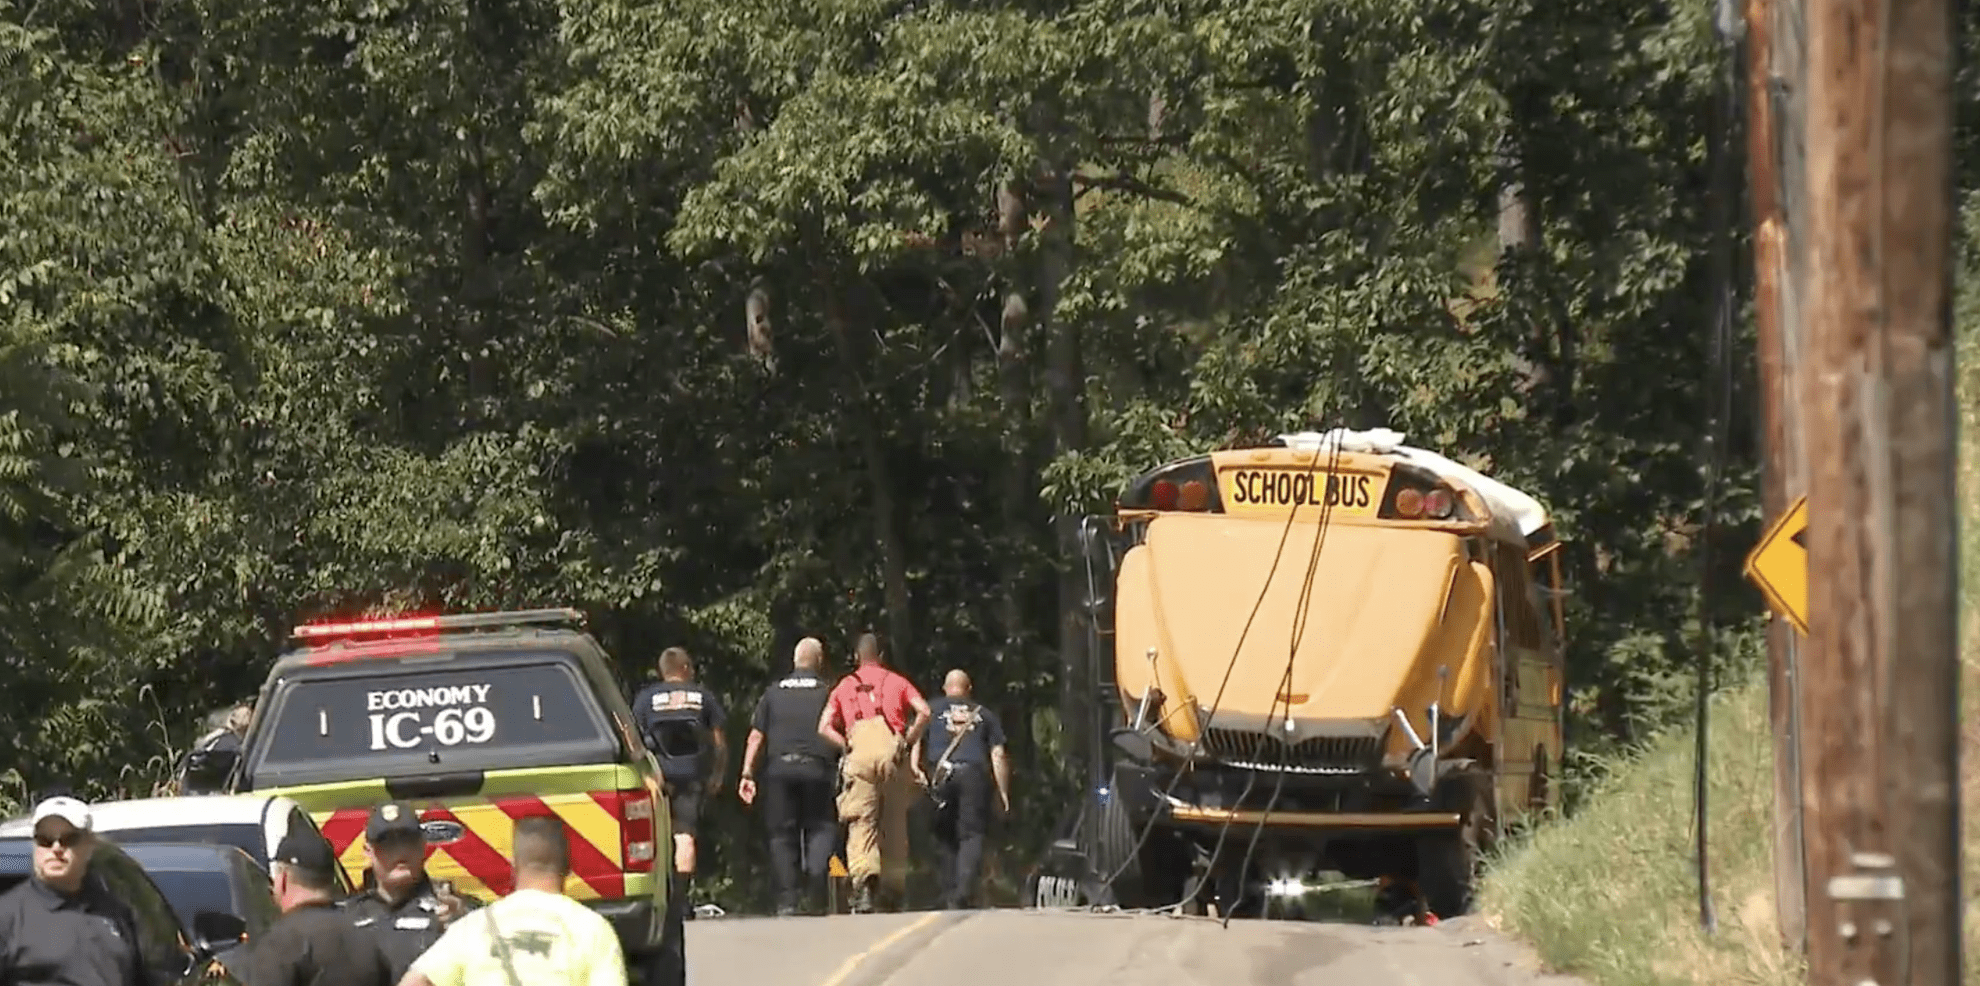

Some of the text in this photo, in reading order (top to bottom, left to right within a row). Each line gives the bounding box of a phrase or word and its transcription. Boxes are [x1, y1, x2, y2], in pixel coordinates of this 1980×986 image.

[1234, 471, 1370, 507] SCHOOL BUS
[367, 684, 492, 711] ECONOMY
[368, 706, 496, 750] IC-69
